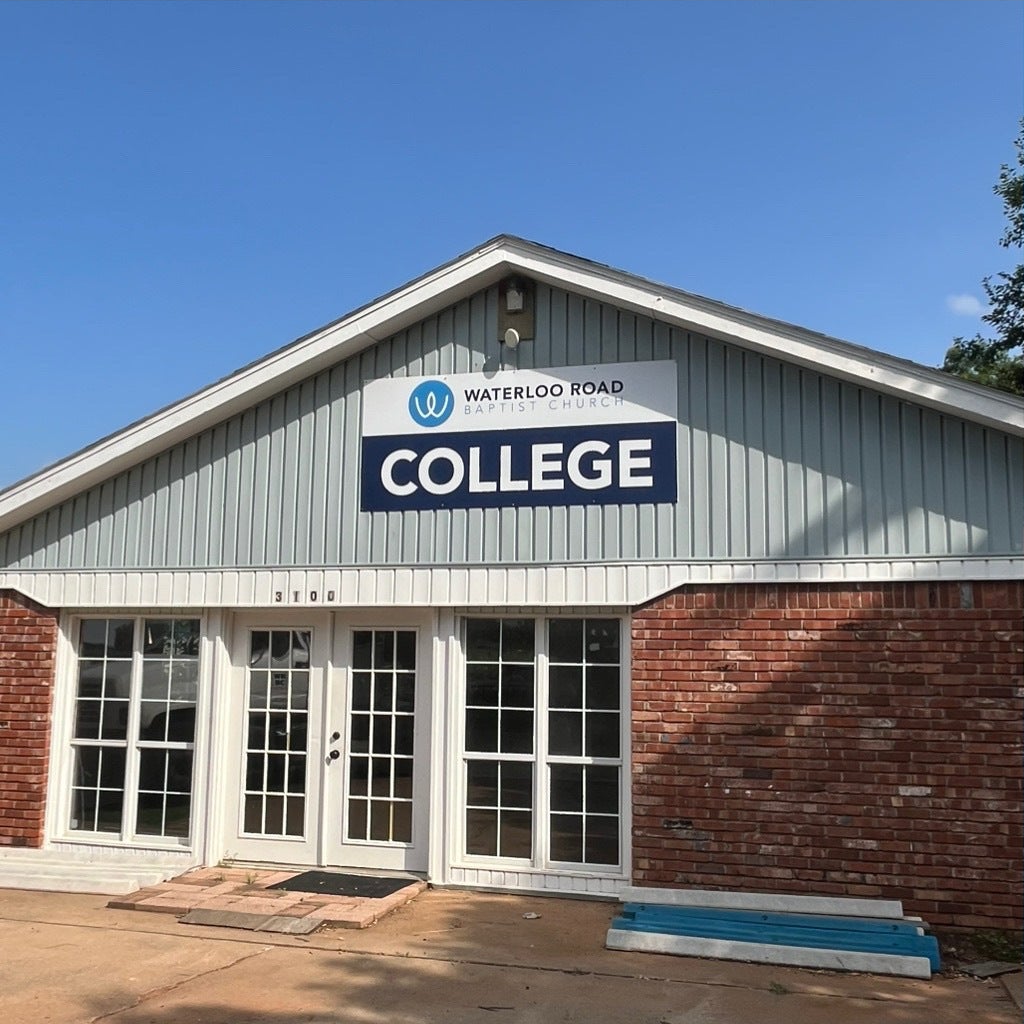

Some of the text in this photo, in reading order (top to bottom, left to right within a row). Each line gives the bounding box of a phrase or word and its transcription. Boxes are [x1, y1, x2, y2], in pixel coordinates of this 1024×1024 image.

[464, 380, 624, 402] WATERLOO ROAD
[464, 396, 624, 415] BAPTIST CHURCH
[380, 438, 653, 496] COLLEGE
[275, 590, 335, 602] 3100
